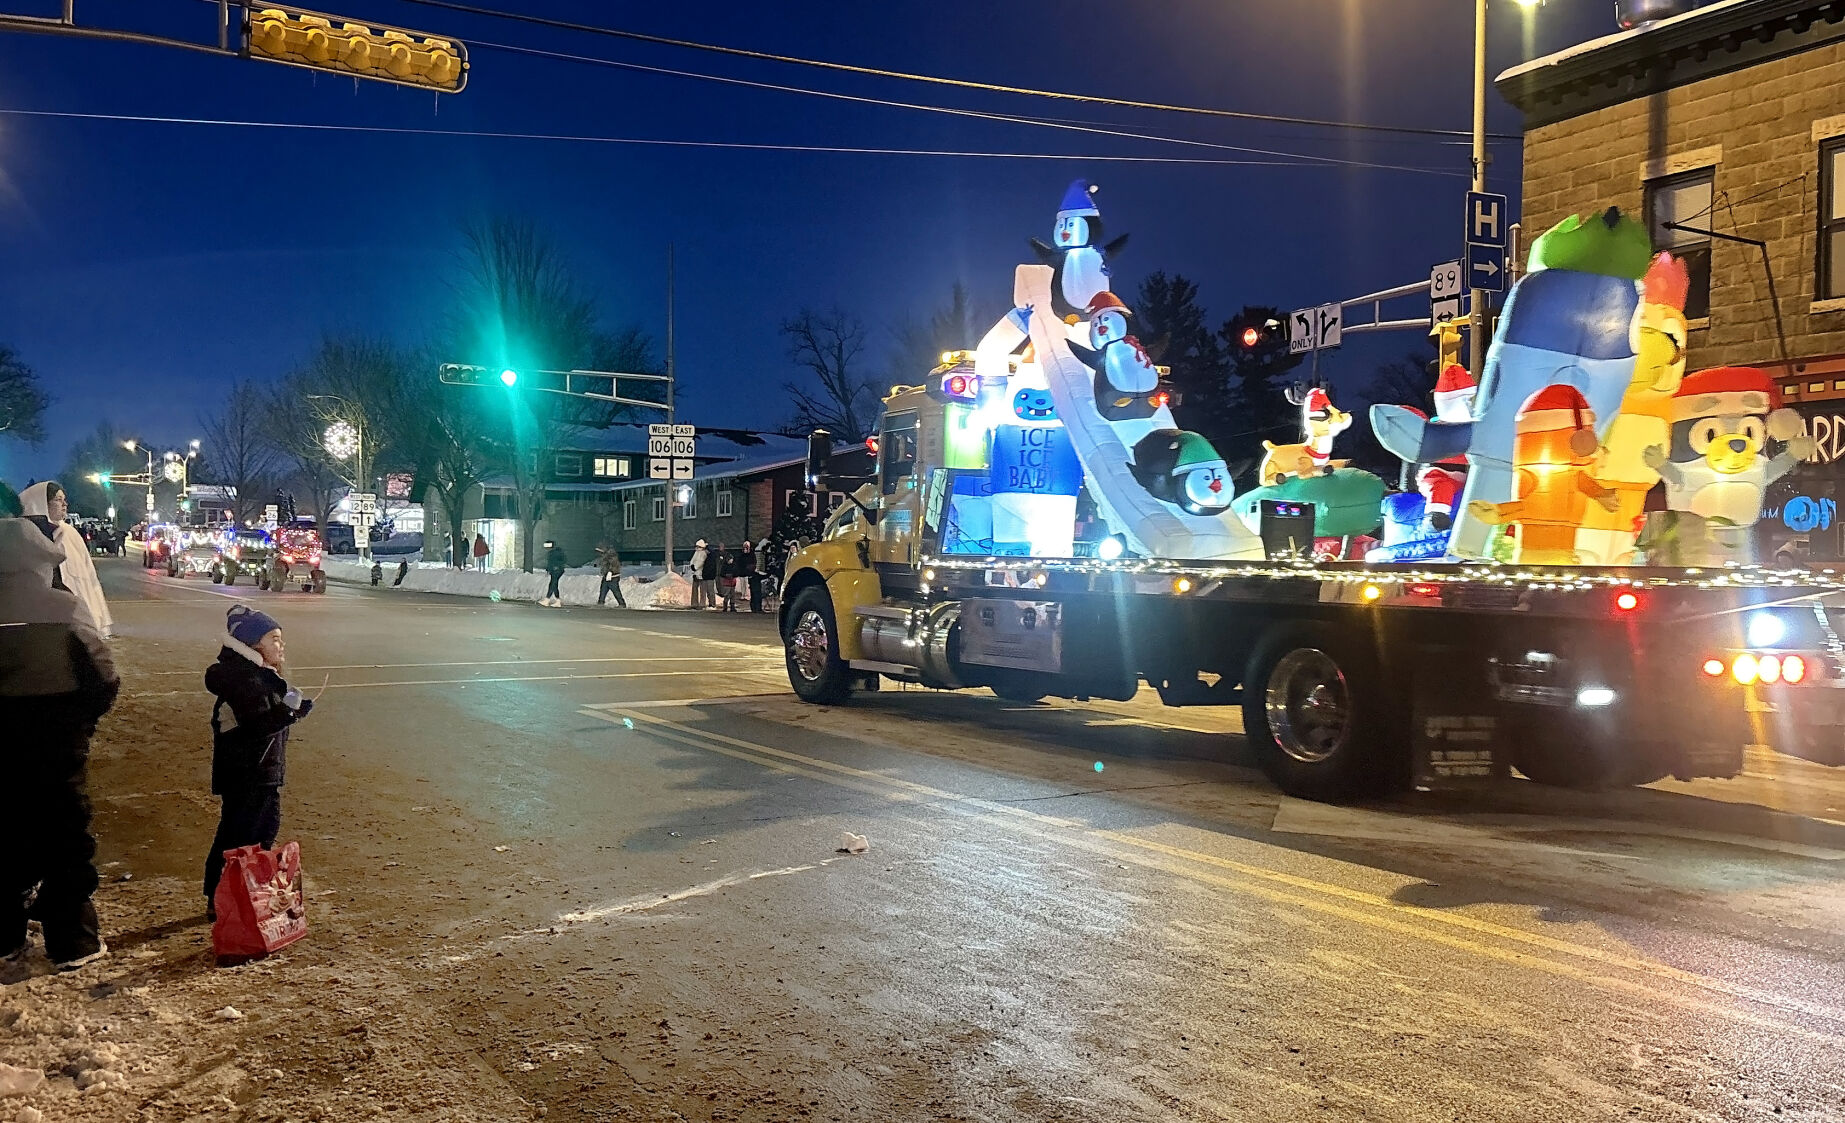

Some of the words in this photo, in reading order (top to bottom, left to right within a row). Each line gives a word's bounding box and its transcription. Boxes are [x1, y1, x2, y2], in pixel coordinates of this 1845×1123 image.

[1475, 200, 1498, 238] H
[1435, 270, 1456, 291] 89
[1292, 337, 1313, 350] ONLY
[651, 425, 670, 433] WEST
[675, 426, 692, 434] EAST
[1021, 428, 1056, 448] ICE
[650, 440, 670, 453] 106
[673, 440, 694, 454] 106
[363, 503, 375, 511] 89
